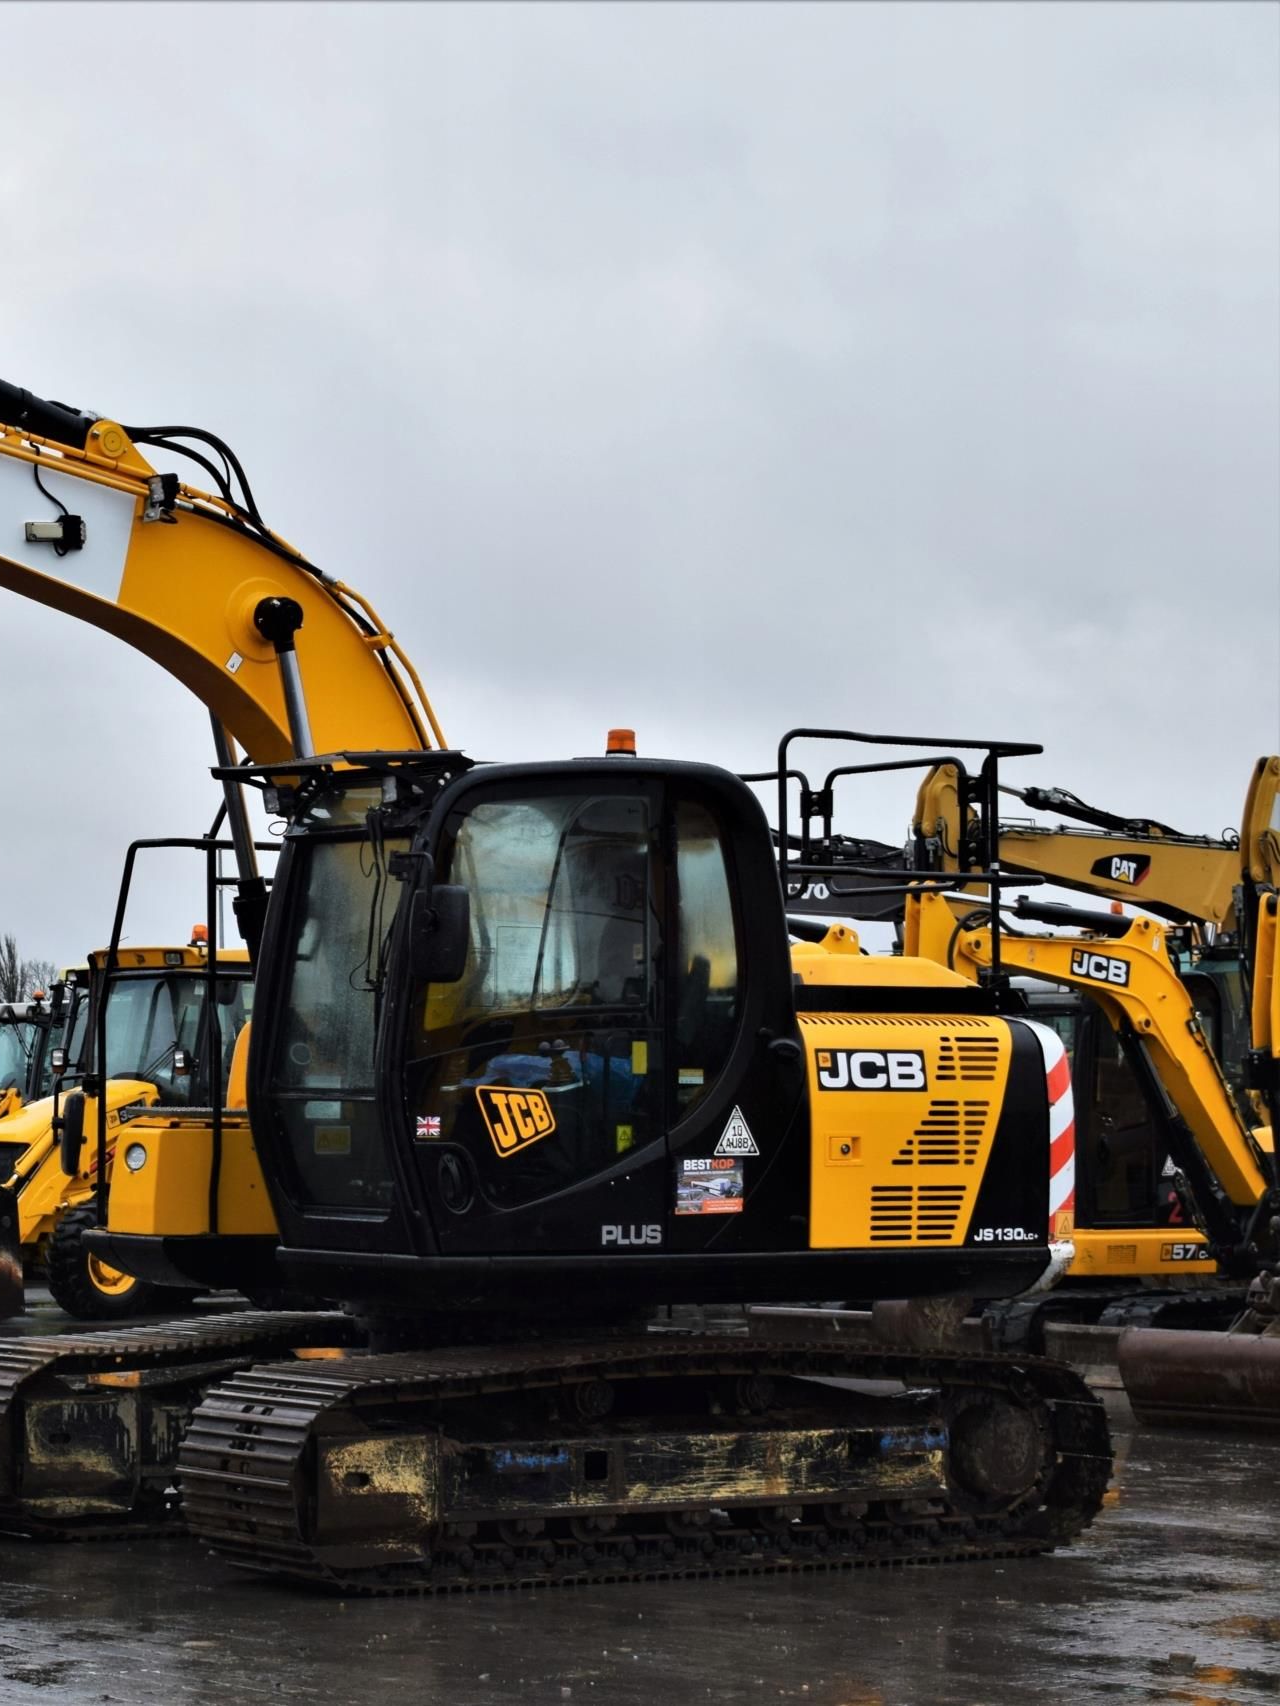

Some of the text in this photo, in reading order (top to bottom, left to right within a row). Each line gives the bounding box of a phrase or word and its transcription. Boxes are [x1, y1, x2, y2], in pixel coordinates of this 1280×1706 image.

[1110, 856, 1137, 883] CAT
[1072, 952, 1128, 985] JCB
[819, 1052, 925, 1089] JCB
[489, 1092, 551, 1149] JCB
[683, 1158, 736, 1171] BESTKOP
[601, 1224, 662, 1245] PLUS
